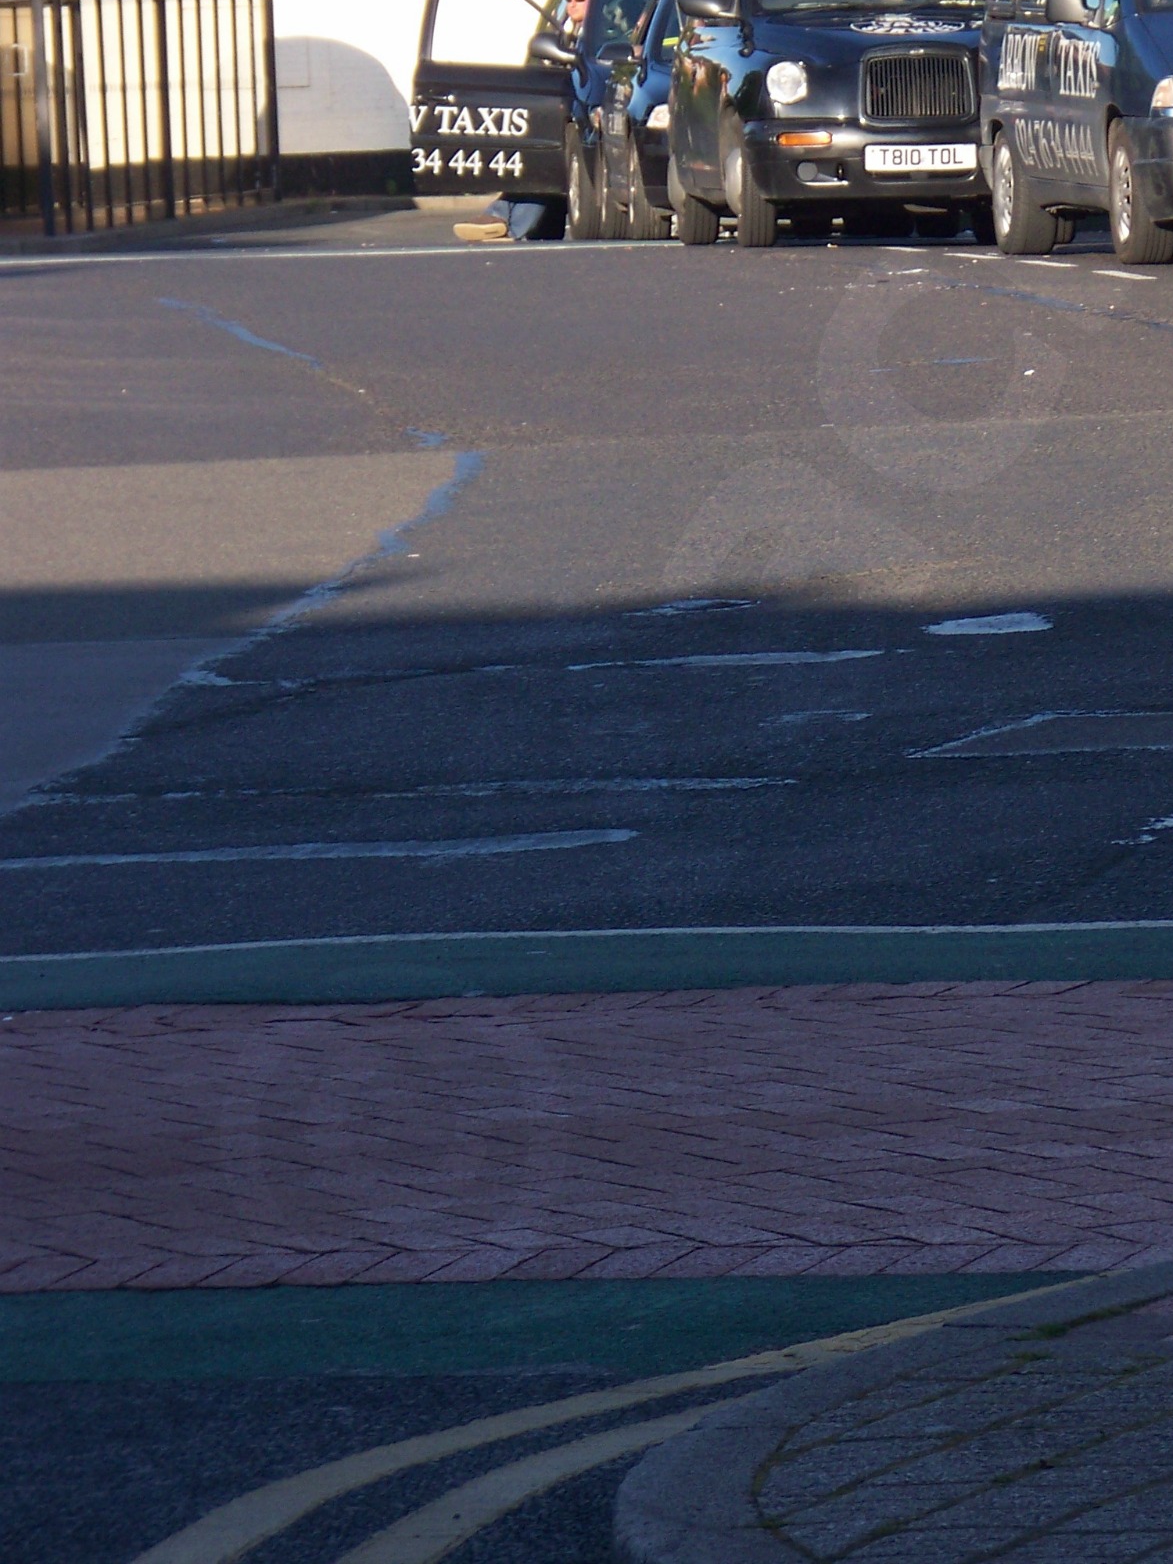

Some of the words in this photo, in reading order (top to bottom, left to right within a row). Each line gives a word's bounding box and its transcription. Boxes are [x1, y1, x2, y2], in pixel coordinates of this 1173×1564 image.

[1059, 38, 1101, 98] TAXIS
[434, 106, 529, 136] TAXIS
[411, 147, 442, 174] 34
[448, 149, 483, 175] 44
[488, 150, 523, 177] 44
[879, 149, 921, 166] T810
[928, 147, 964, 165] TOL
